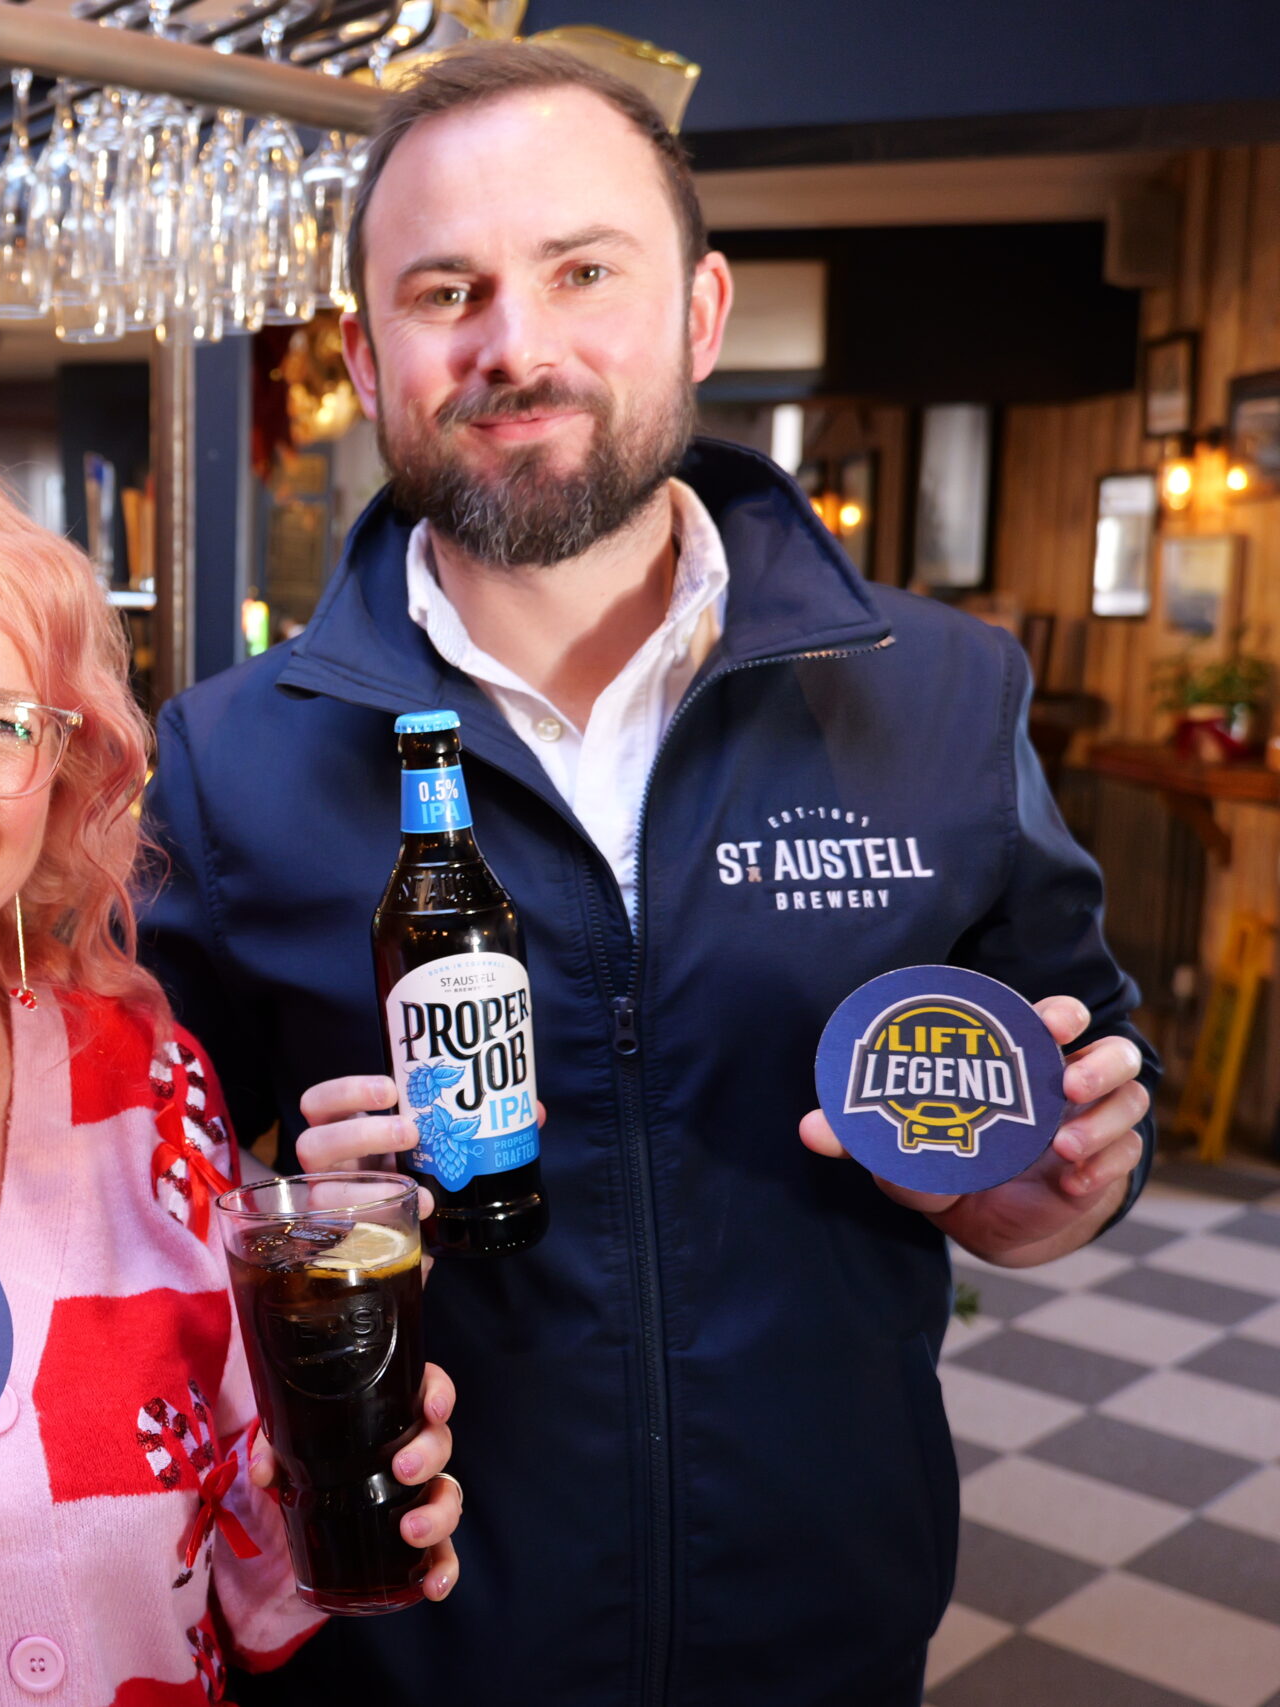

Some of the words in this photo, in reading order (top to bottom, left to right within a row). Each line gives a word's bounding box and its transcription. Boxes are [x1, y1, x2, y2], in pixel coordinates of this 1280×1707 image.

[419, 778, 459, 802] 0.5%
[421, 801, 461, 825] IPA
[774, 837, 935, 881] AUSTELL
[776, 889, 889, 911] BREWERY
[400, 987, 529, 1062] PROPER
[888, 1024, 986, 1056] LIFT
[455, 1030, 527, 1111] JOB
[860, 1053, 1015, 1107] LEGEND
[489, 1090, 533, 1131] IPA
[493, 1131, 534, 1150] PROPERLY
[495, 1141, 535, 1168] CRAFTED
